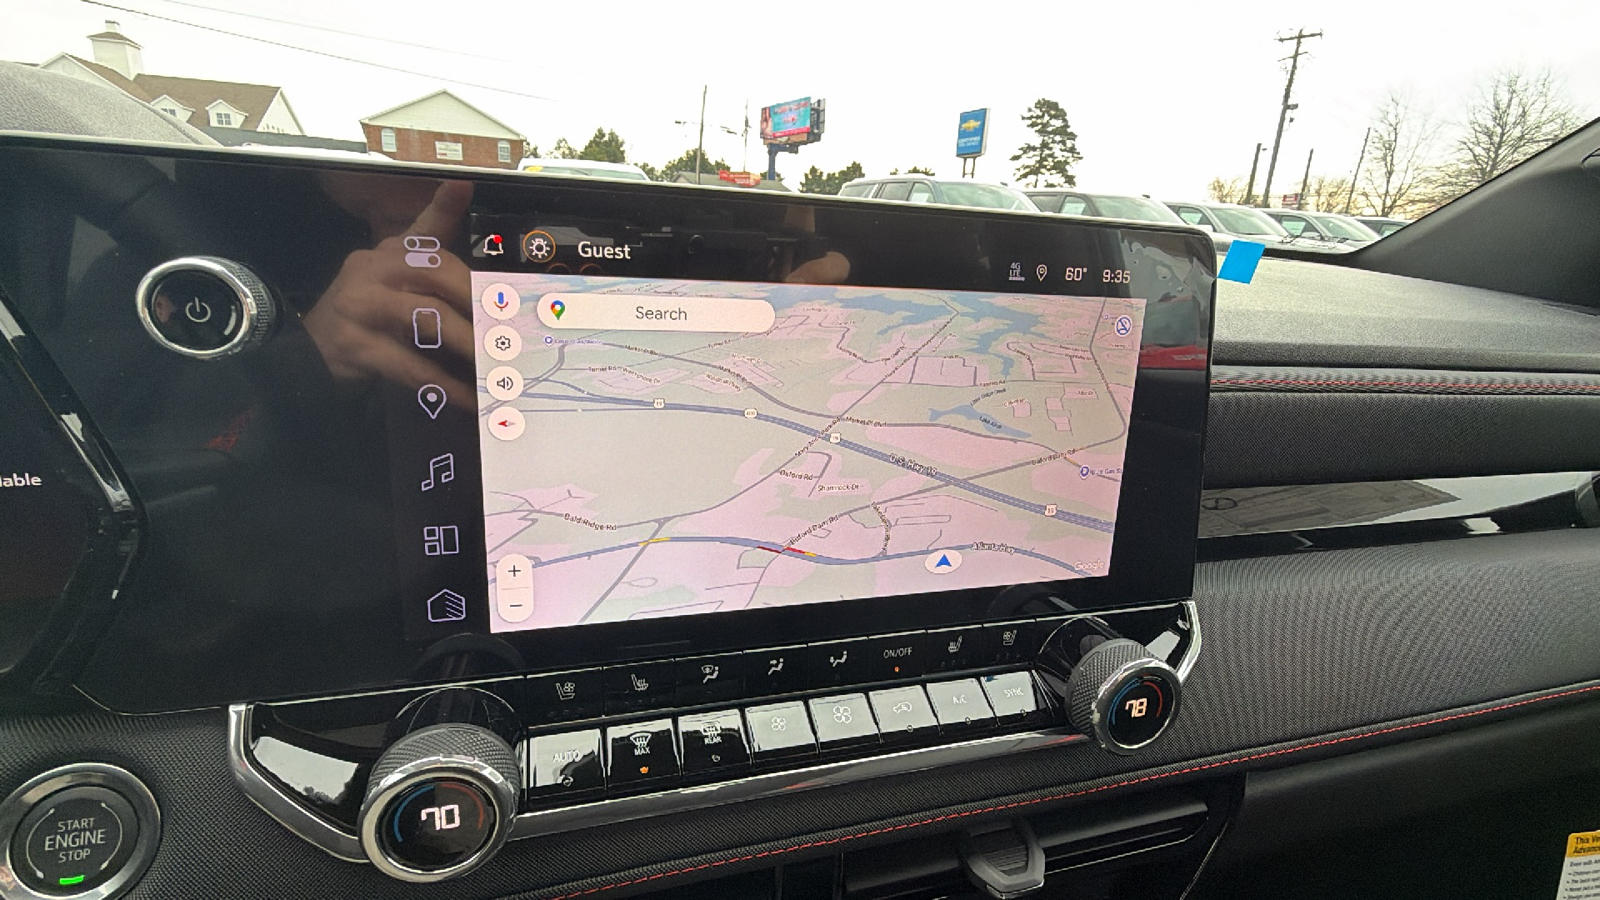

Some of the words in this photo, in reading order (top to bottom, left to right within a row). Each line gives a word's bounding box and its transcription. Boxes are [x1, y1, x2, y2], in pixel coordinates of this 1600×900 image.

[578, 241, 631, 260] Guest
[1065, 267, 1088, 281] 60°
[1102, 269, 1131, 284] 9:35
[635, 305, 688, 321] Search
[846, 416, 866, 426] Market
[779, 469, 802, 480] Oxford
[803, 473, 813, 481] Rd
[907, 459, 926, 474] Hwy
[927, 466, 938, 478] 19
[817, 484, 849, 492] Shamrock
[851, 483, 860, 491] Dr
[563, 513, 582, 525] Bald
[582, 517, 604, 532] Ridge
[605, 523, 617, 532] Rd
[790, 527, 811, 545] Buford
[828, 514, 838, 524] Rd
[1074, 559, 1104, 572] Google
[883, 647, 912, 659] ON/OFF
[1003, 686, 1024, 698] SYNC
[952, 695, 968, 705] A/C
[1124, 697, 1148, 718] 78
[704, 736, 722, 745] REAR
[552, 749, 581, 763] AUTO
[634, 747, 651, 755] MAX
[420, 804, 460, 831] 70
[58, 817, 96, 833] START
[44, 828, 108, 851] ENGINE
[58, 848, 91, 863] STOP
